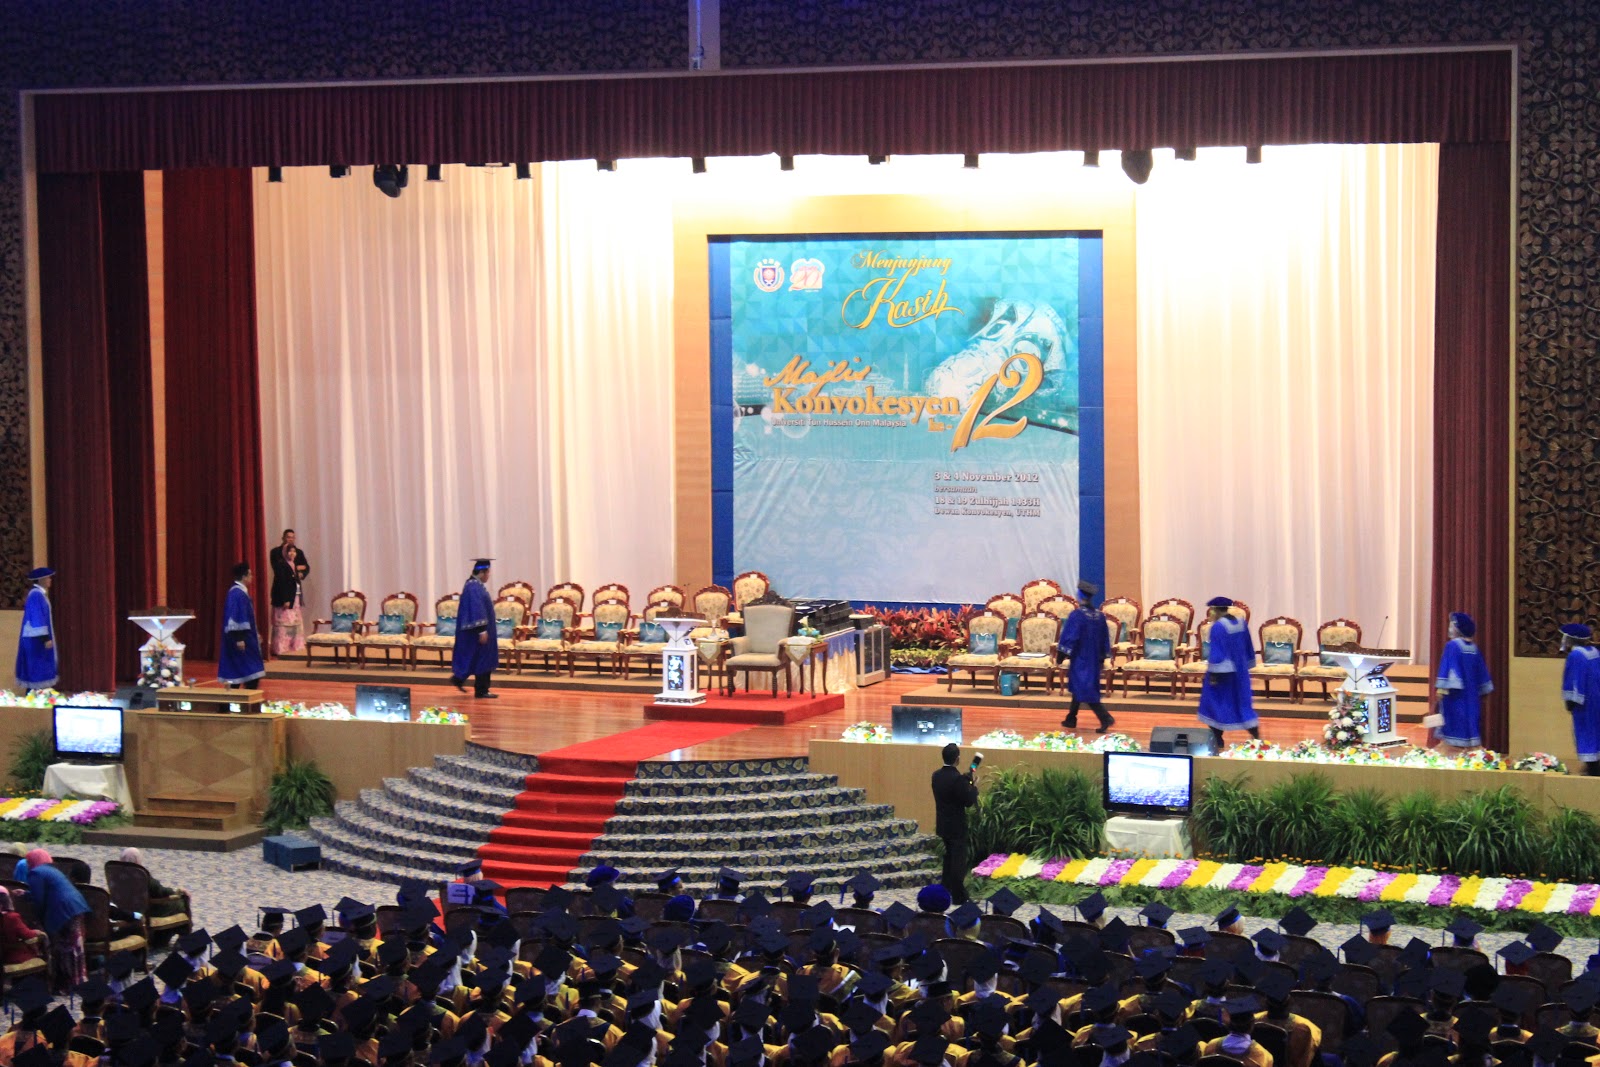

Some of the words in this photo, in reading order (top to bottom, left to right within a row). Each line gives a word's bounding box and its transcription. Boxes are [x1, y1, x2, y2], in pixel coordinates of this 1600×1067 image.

[841, 267, 965, 329] Kasih
[763, 354, 873, 398] Majlis
[771, 386, 961, 425] Konvokesyen
[951, 352, 1044, 453] 12
[808, 419, 822, 427] Tun
[823, 419, 853, 427] Hussein
[855, 419, 871, 428] Onn
[872, 420, 907, 429] Malaysia
[934, 472, 941, 480] 3
[942, 472, 951, 480] &
[953, 472, 960, 481] 4
[962, 472, 1012, 482] November
[1014, 473, 1039, 483] 2012
[934, 507, 960, 515] Dewan
[961, 507, 1014, 518] Konvokesyen,
[1015, 509, 1040, 518] UTHM
[935, 496, 946, 505] 18
[947, 496, 956, 505] &
[957, 496, 968, 505] 19
[969, 496, 1010, 508] Zulhijjah
[1011, 498, 1040, 507] 1433H
